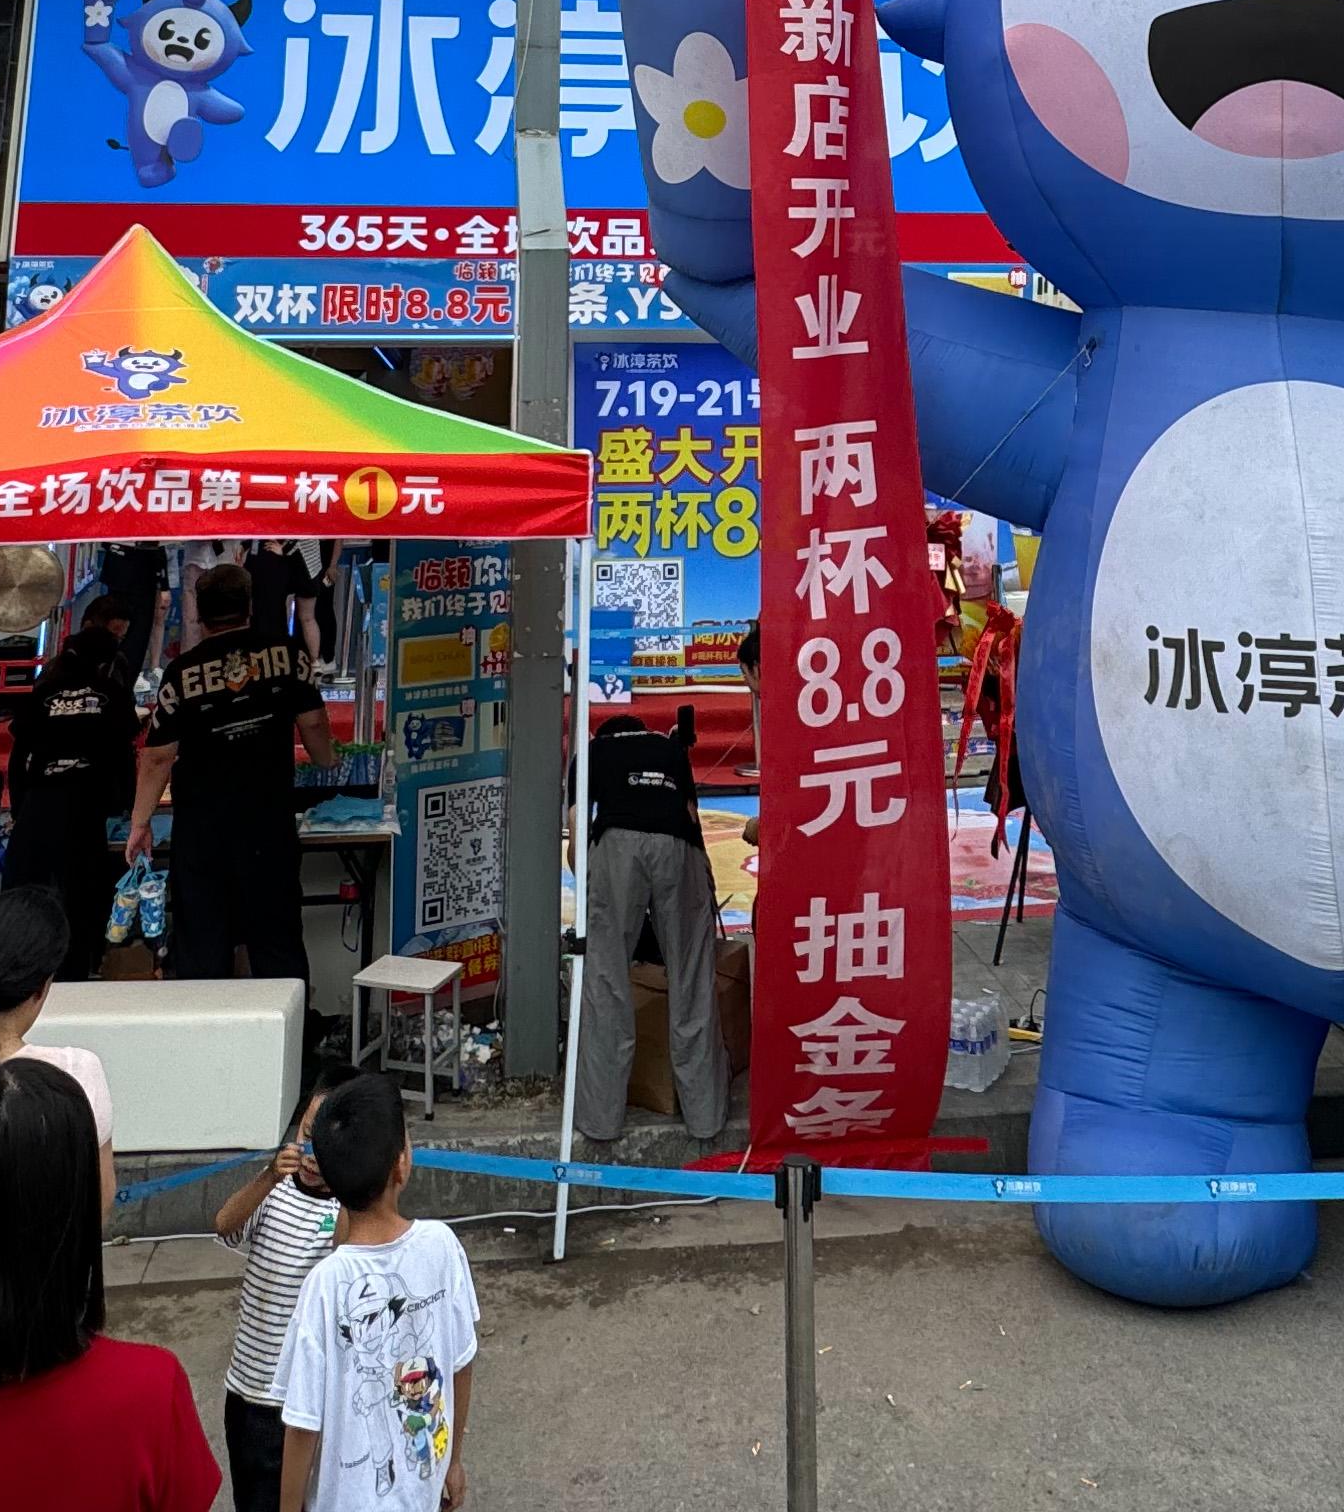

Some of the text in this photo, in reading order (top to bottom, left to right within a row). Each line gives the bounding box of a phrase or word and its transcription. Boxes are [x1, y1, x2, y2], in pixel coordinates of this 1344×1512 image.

[233, 281, 691, 326] 双杯限时8.8元 条、YS
[37, 403, 243, 427] 冰淳茶饮
[784, 891, 907, 1142] 抽金条
